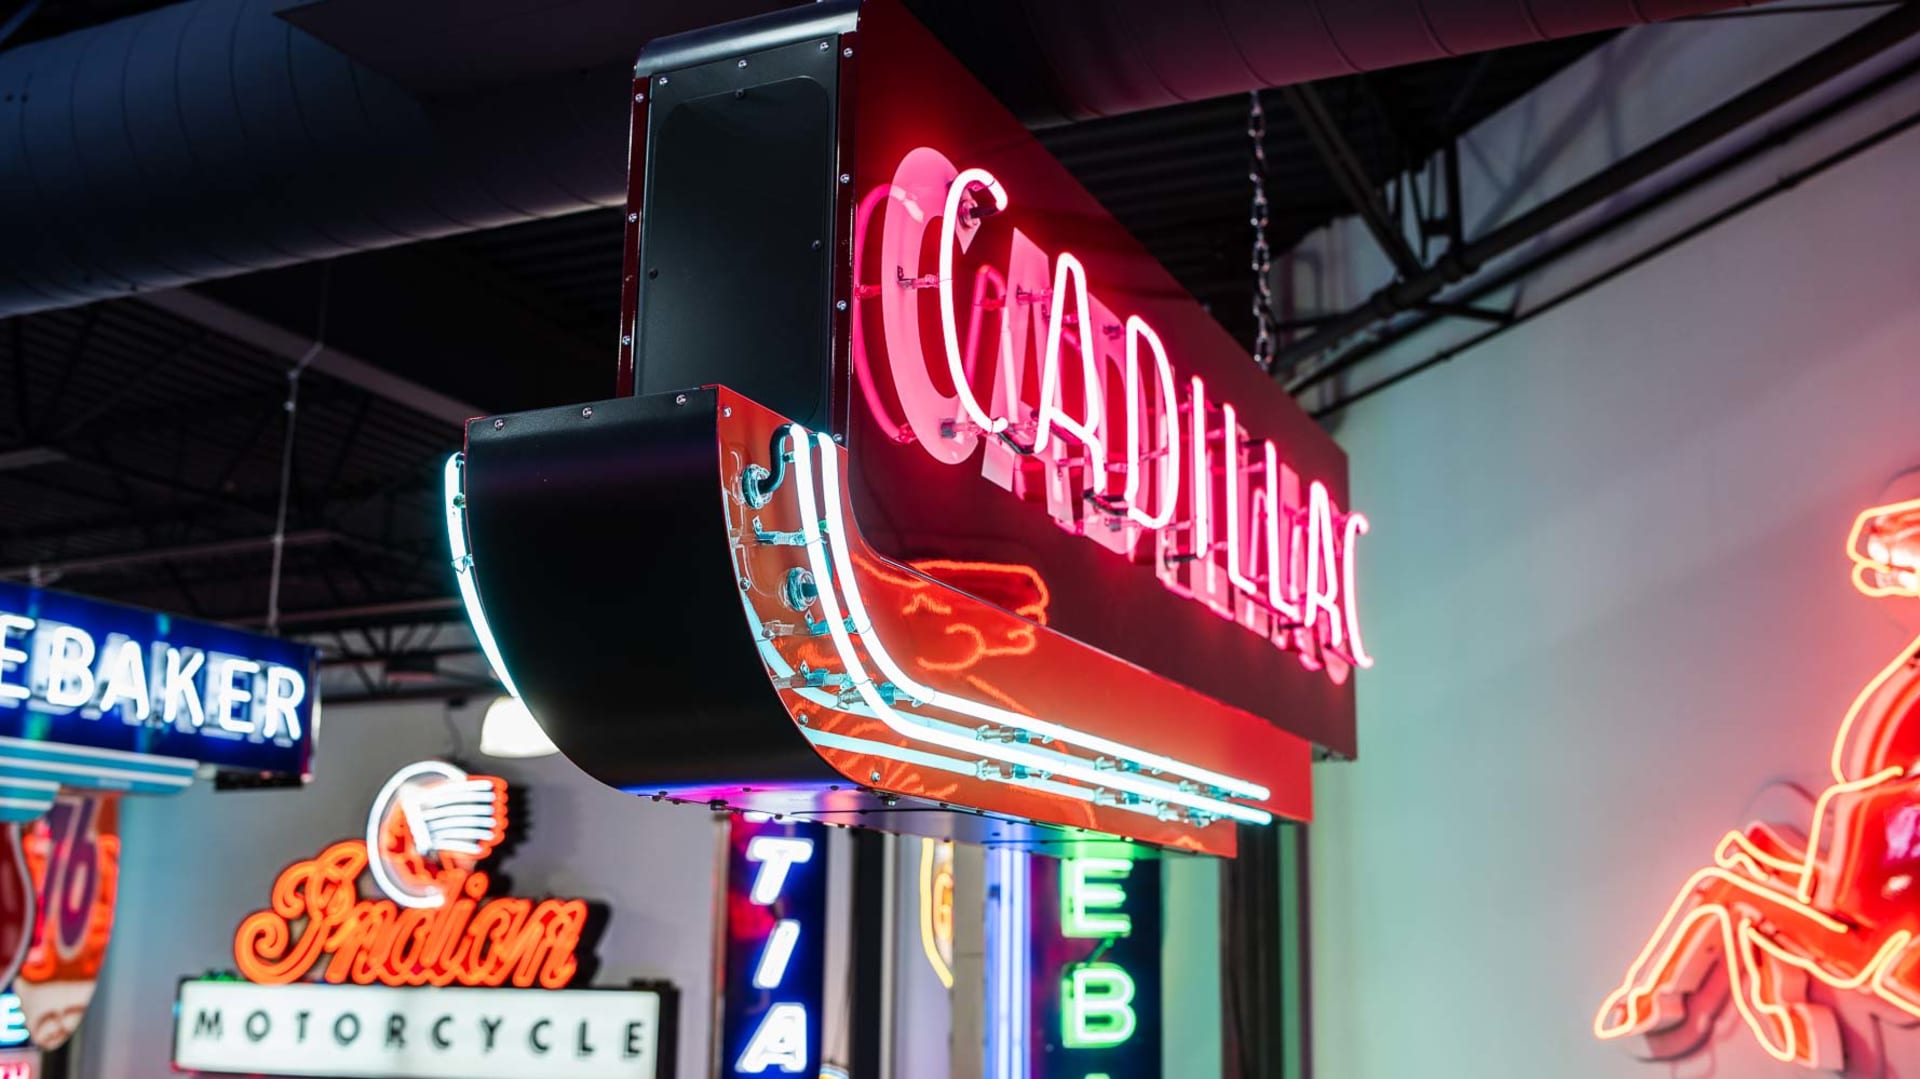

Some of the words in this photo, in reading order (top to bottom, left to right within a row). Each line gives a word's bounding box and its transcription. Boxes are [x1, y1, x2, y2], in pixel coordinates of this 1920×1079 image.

[882, 147, 1374, 686] CADILLAC
[0, 612, 307, 746] EBAKER
[233, 839, 589, 989] Indian
[735, 808, 814, 1074] TIA
[194, 1009, 644, 1059] MOTORCYCLE
